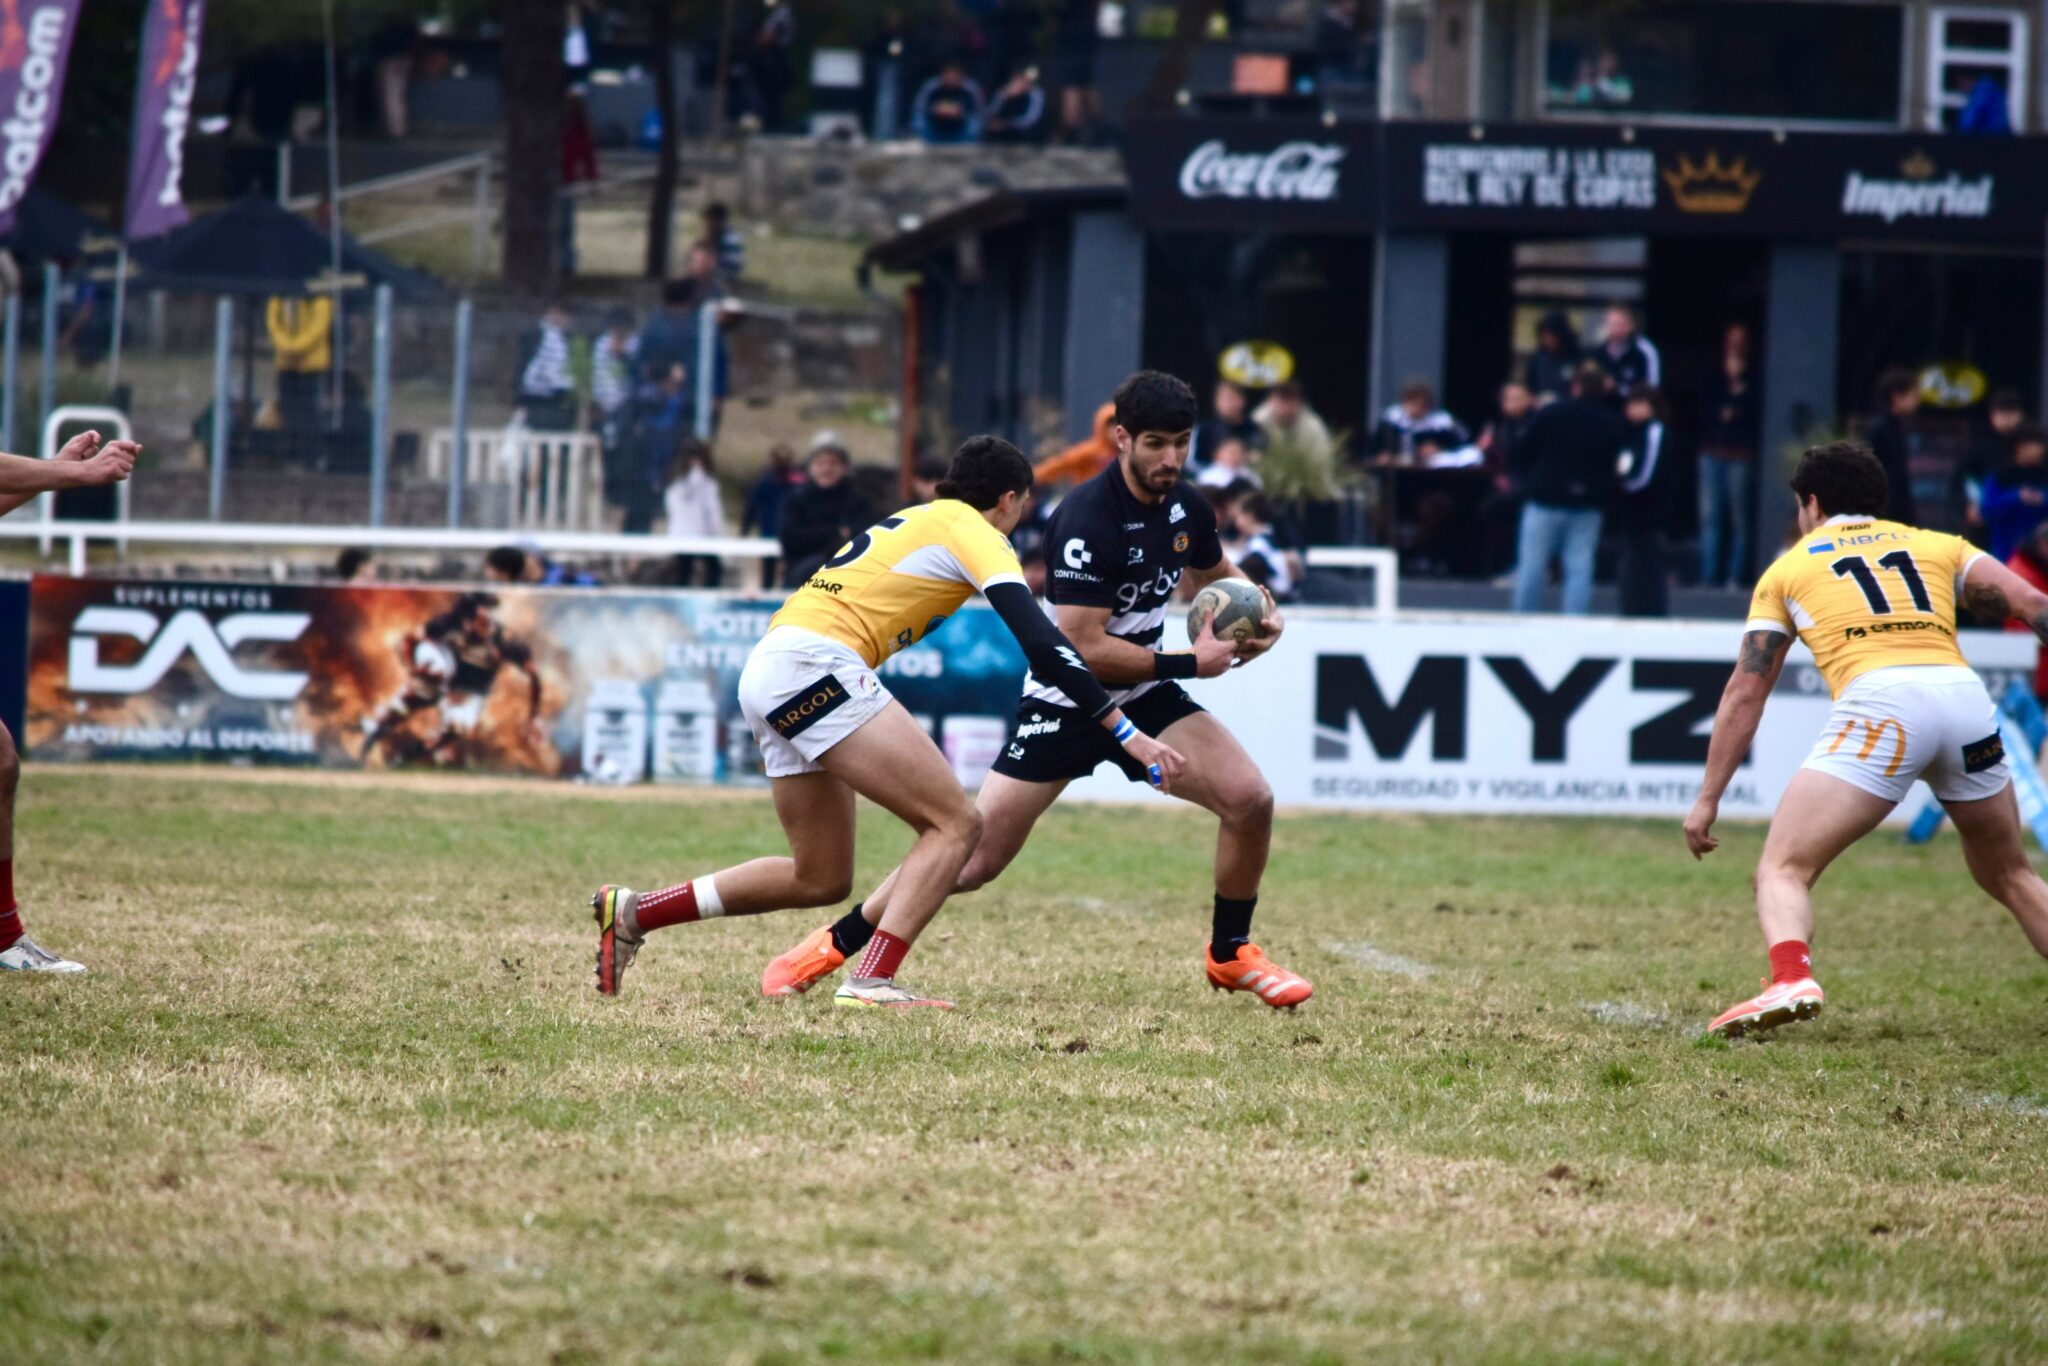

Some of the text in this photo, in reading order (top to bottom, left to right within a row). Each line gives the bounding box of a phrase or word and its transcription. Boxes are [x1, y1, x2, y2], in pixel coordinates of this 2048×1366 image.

[1425, 172, 1471, 205] DEL
[1478, 172, 1524, 206] REY
[1533, 175, 1567, 207] DE
[1842, 169, 1993, 225] Imperial
[114, 586, 272, 609] SUPLEMENTOS
[1831, 550, 1934, 615] 11
[68, 606, 312, 700] DAC
[1314, 653, 1752, 765] MYZ
[63, 724, 185, 746] APOYANDO
[188, 727, 213, 747] AL
[1313, 776, 1458, 799] SEGURIDAD
[1466, 780, 1483, 798] Y
[1489, 780, 1629, 801] VIGILANCIA
